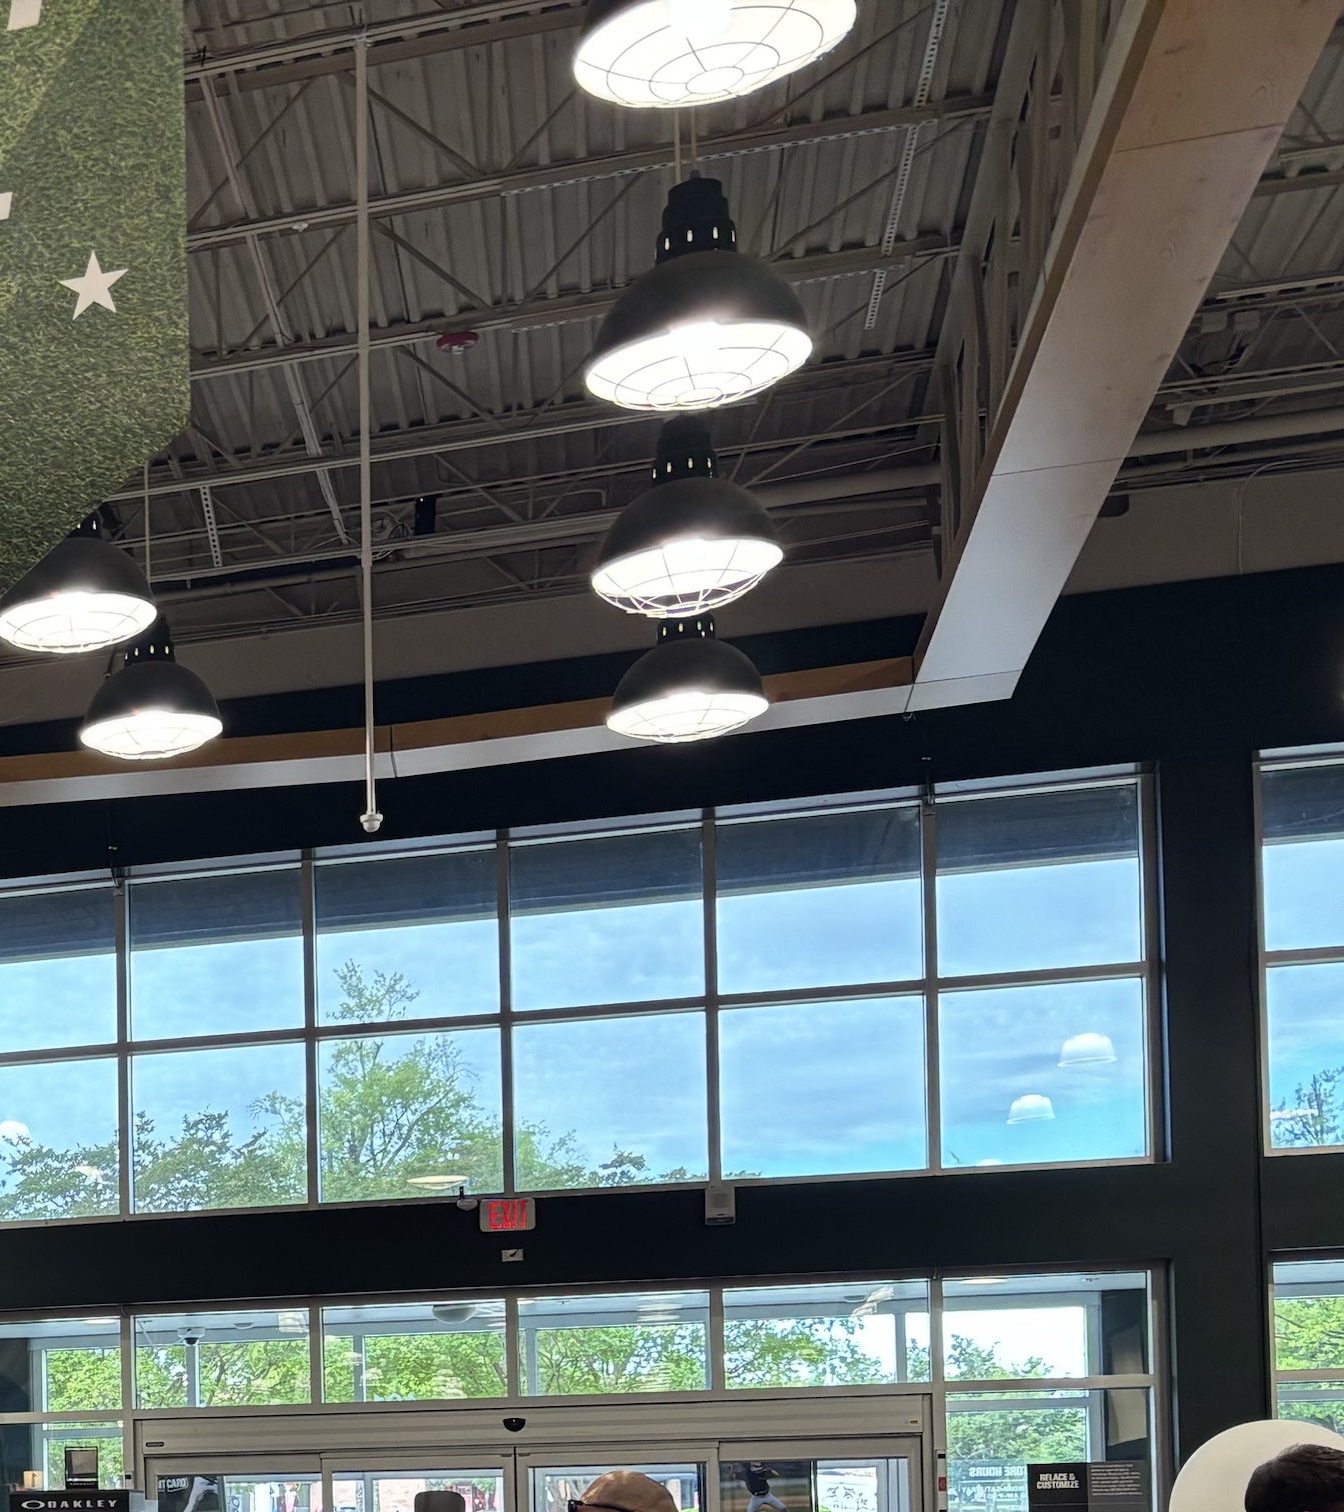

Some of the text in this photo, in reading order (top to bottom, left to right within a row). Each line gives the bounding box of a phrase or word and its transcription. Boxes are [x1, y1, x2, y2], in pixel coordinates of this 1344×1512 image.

[488, 1199, 529, 1230] EXIT
[1036, 1481, 1080, 1490] CUSTOMIZE
[47, 1499, 118, 1509] OAKLEY
